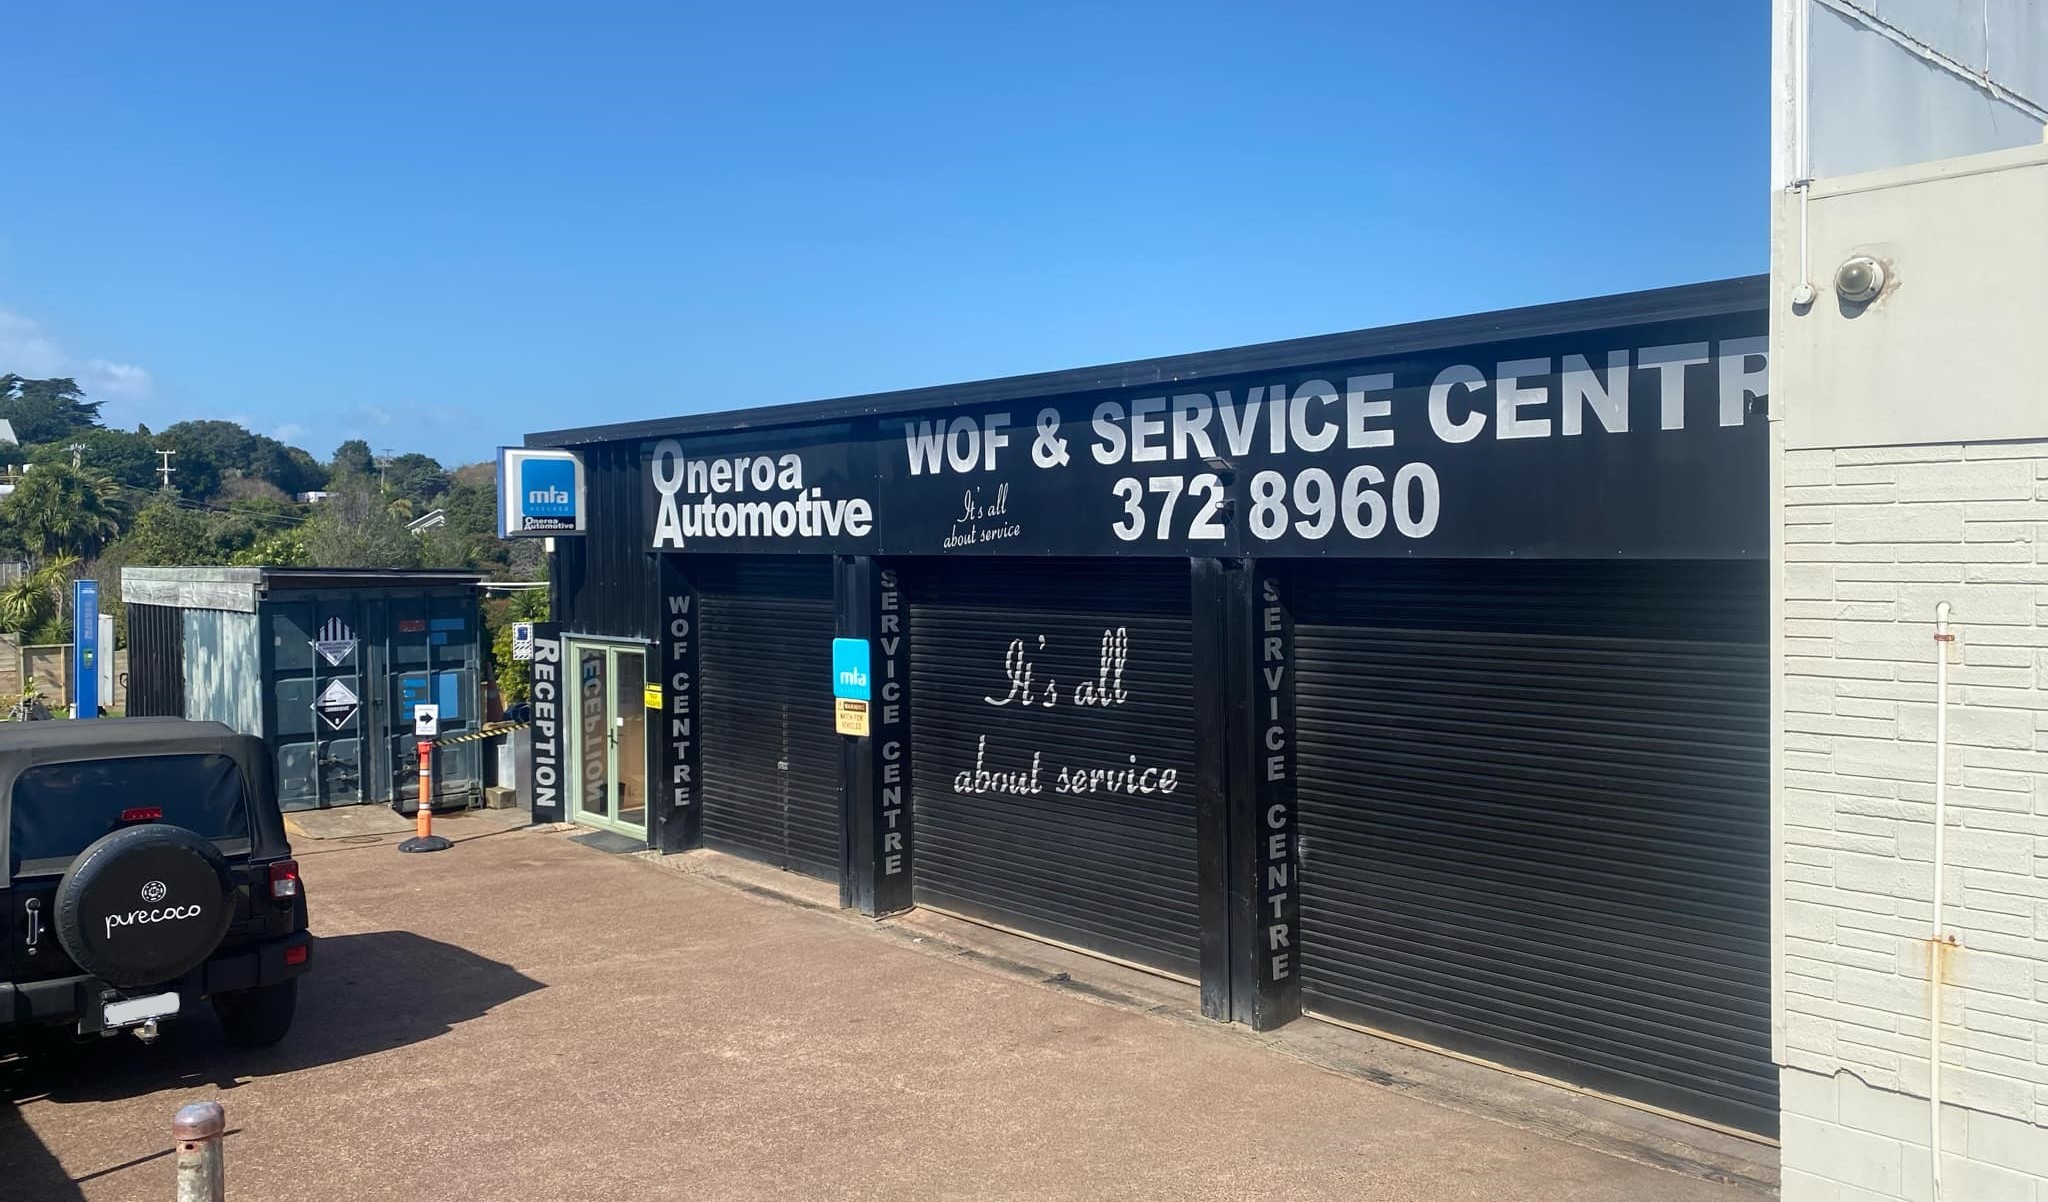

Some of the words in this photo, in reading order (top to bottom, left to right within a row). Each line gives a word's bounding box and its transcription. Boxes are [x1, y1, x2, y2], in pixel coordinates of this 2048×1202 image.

[904, 412, 1010, 476] WOF
[1031, 407, 1071, 469] &
[1091, 372, 1396, 465] SERVICE
[529, 485, 569, 504] mta
[651, 438, 803, 495] Oneroa
[956, 485, 983, 523] It's
[987, 482, 1009, 517] all
[1112, 472, 1226, 541] 372
[1249, 461, 1441, 541] 8960
[651, 487, 873, 549] Automotive
[943, 523, 977, 548] about
[980, 521, 1021, 542] service
[668, 595, 691, 660] WOF
[880, 570, 900, 725] SERVICE
[984, 634, 1058, 708] It's
[1074, 626, 1128, 706] all
[1263, 577, 1286, 782] SERVICE
[534, 637, 561, 807] RECEPTION
[672, 672, 691, 807] CENTRE
[954, 734, 1043, 794] about
[1055, 754, 1178, 794] service
[882, 741, 903, 876] CENTRE
[105, 904, 201, 939] purecoco
[1267, 804, 1290, 981] CENTRE
